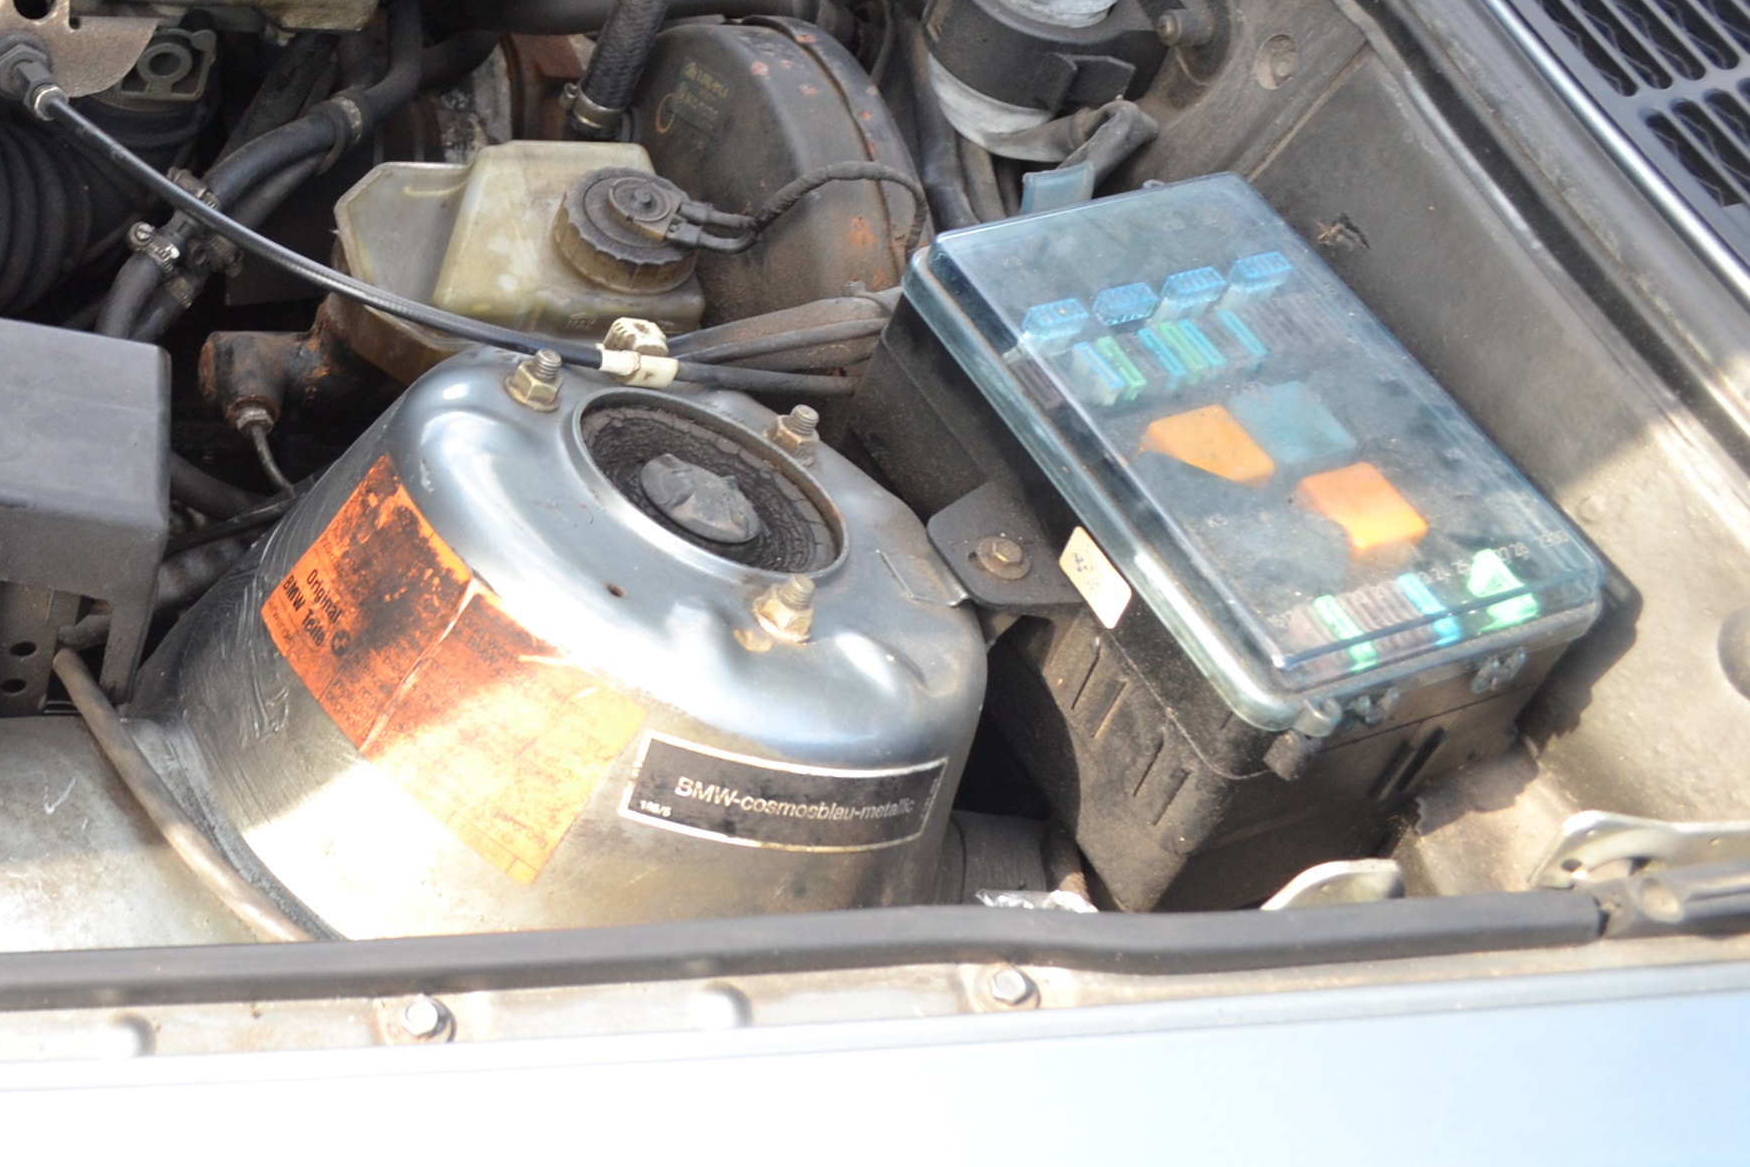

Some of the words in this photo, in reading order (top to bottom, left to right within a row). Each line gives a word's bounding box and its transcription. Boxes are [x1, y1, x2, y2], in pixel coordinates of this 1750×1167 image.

[282, 575, 306, 612] BMW
[301, 608, 326, 647] Teile
[305, 568, 344, 624] Original
